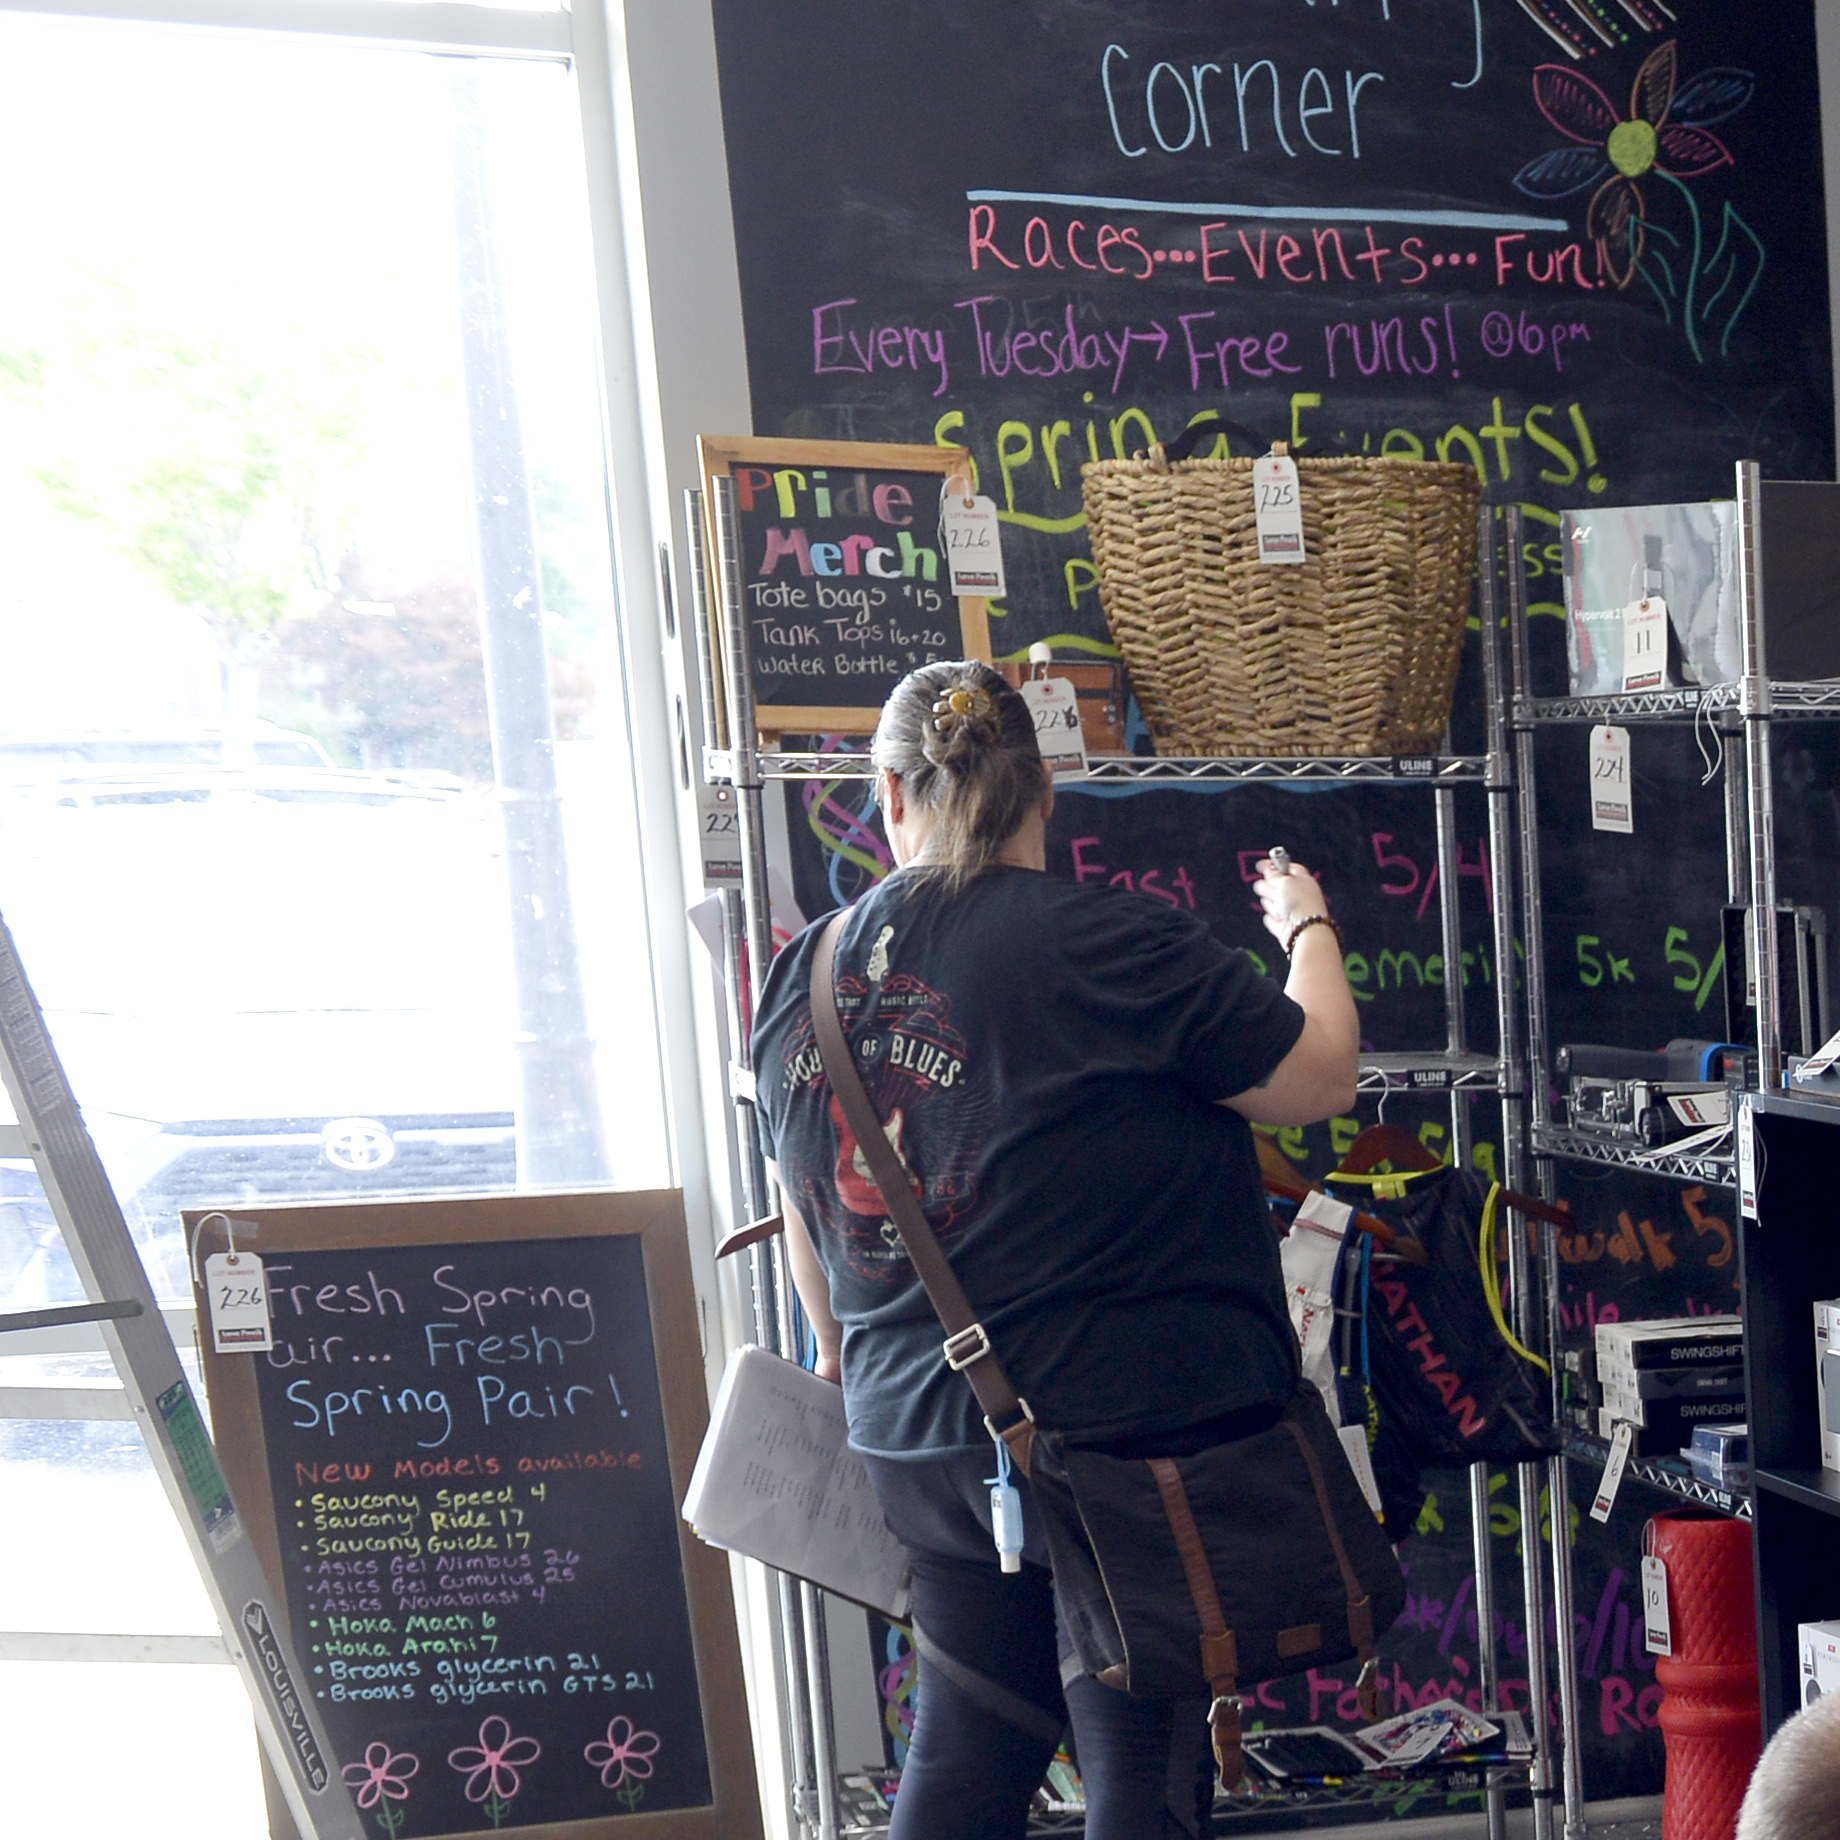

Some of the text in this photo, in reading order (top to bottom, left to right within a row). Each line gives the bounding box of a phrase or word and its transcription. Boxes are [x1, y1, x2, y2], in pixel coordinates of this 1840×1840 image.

[1102, 43, 1384, 159] Corner
[1495, 233, 1606, 290] Fun!
[811, 297, 944, 397] Every
[965, 296, 1131, 394] Tuesday
[1178, 310, 1303, 391] Free
[1324, 303, 1461, 379] runs!
[735, 466, 913, 526] Pride
[758, 527, 938, 582] Merch
[748, 581, 809, 609] Tote
[817, 580, 886, 625] bags
[752, 616, 820, 647] Tank
[823, 616, 884, 652] Tops
[756, 656, 826, 676] Water
[834, 651, 899, 676] Bottle
[1400, 760, 1434, 773] ULINE
[788, 1034, 963, 1091] HOU OF BLUES
[1413, 1070, 1447, 1084] ULINE
[265, 1265, 595, 1345] Fresh Spring
[426, 1322, 564, 1367] Fresh
[1370, 1247, 1486, 1438] NATHAN
[286, 1379, 451, 1448] Spring
[295, 1449, 642, 1487] New Models available
[312, 1483, 546, 1517] Saucony Speed 4
[314, 1509, 524, 1535] Saucony Ride 17
[317, 1532, 531, 1557] Saucony Guide 17
[318, 1549, 581, 1575] Asics Gel Nimbus 26
[328, 1610, 497, 1636] Hoka Mach 6
[329, 1652, 599, 1687] Brooks glycerin 21
[331, 1672, 655, 1704] Brooks glycerin GTS 21
[258, 1632, 326, 1790] LOUISVILLE
